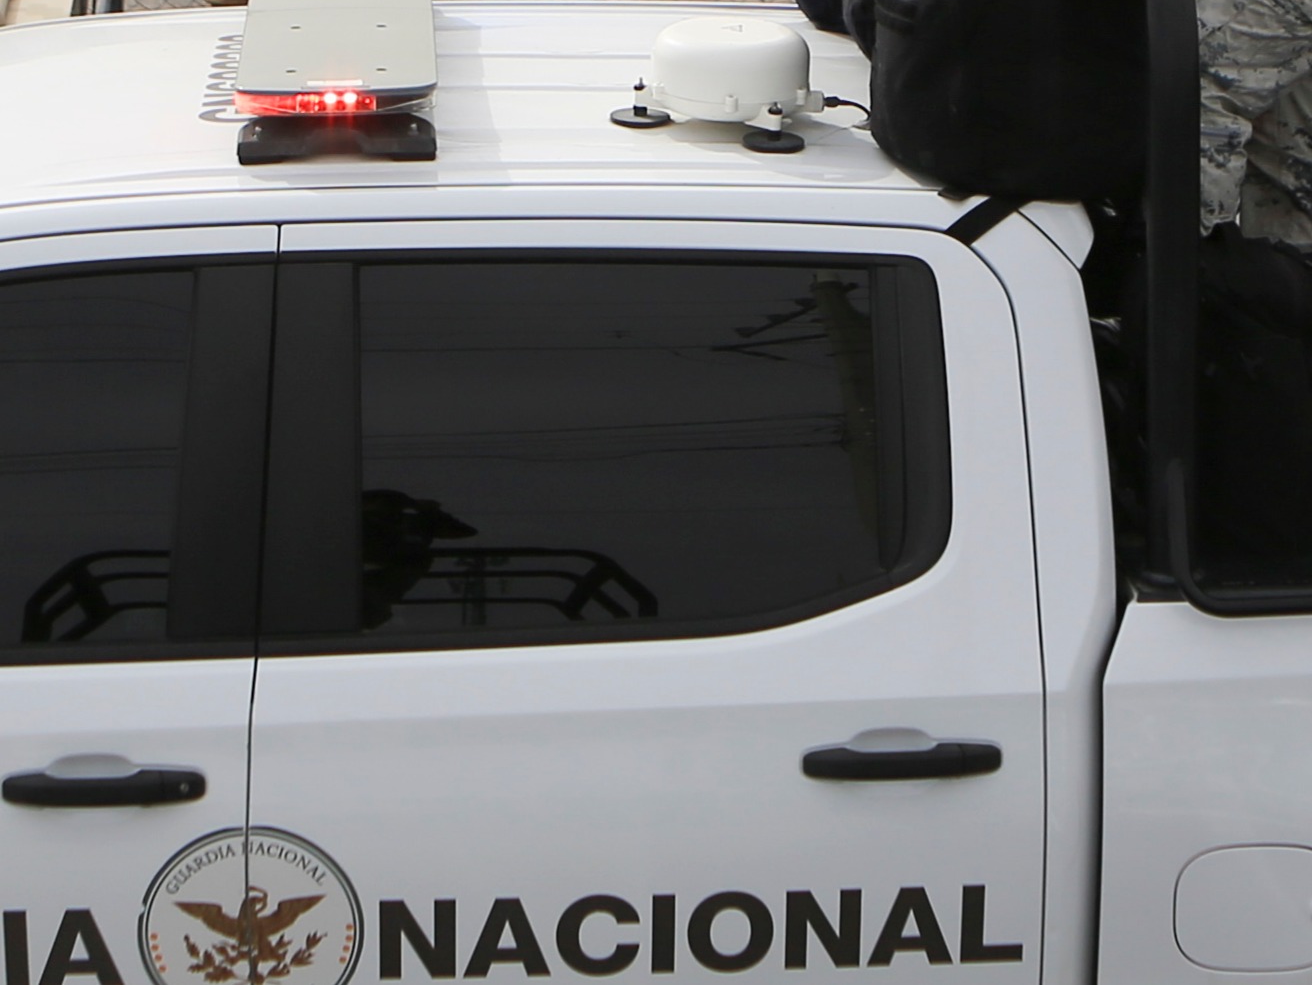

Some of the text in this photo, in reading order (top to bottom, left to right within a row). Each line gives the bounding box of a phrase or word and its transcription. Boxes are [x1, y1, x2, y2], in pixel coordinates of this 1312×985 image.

[165, 841, 327, 895] GUARDIA NACIONAL
[379, 884, 1023, 980] NACIONAL
